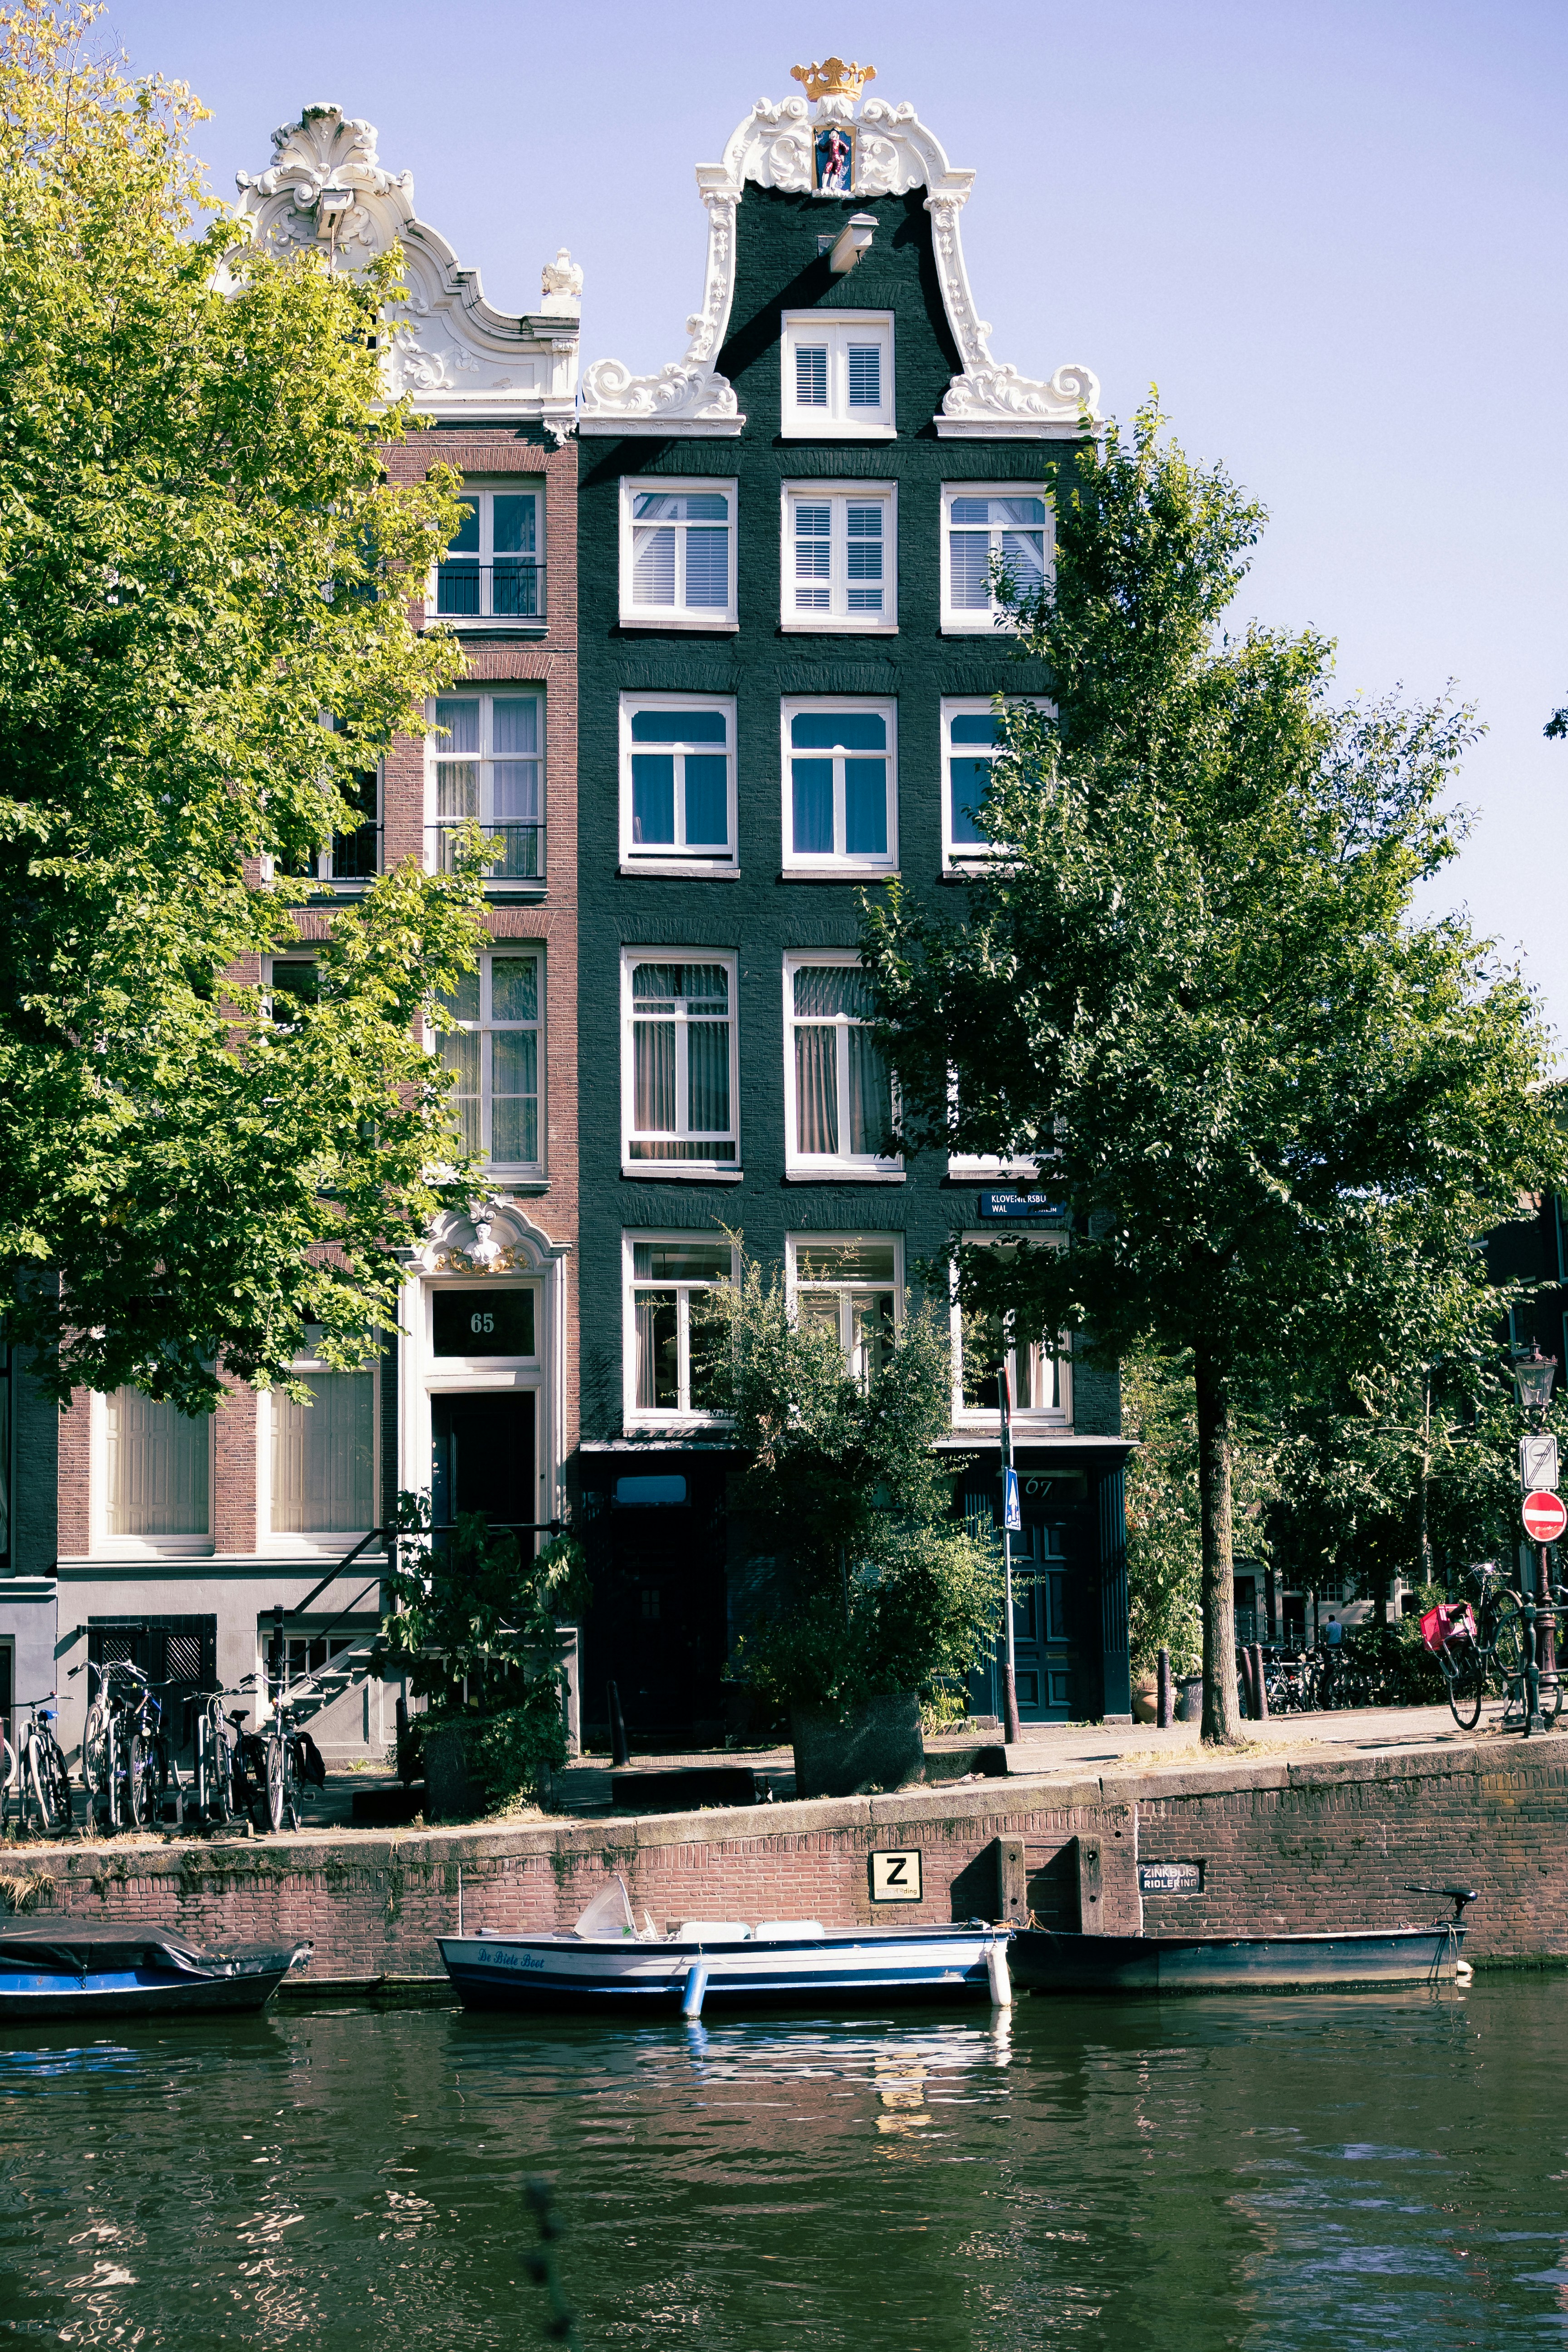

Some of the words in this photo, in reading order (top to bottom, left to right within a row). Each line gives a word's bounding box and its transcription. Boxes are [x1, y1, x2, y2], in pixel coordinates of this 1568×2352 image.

[991, 1195, 1046, 1203] KLOVENIERSBU
[471, 1313, 494, 1333] 65
[1025, 1476, 1053, 1498] 67
[887, 1857, 908, 1885] Z
[1144, 1867, 1197, 1878] ZINKBUIS
[1144, 1879, 1197, 1888] RIOLERING
[478, 1948, 491, 1962] De
[520, 1954, 545, 1968] Boot
